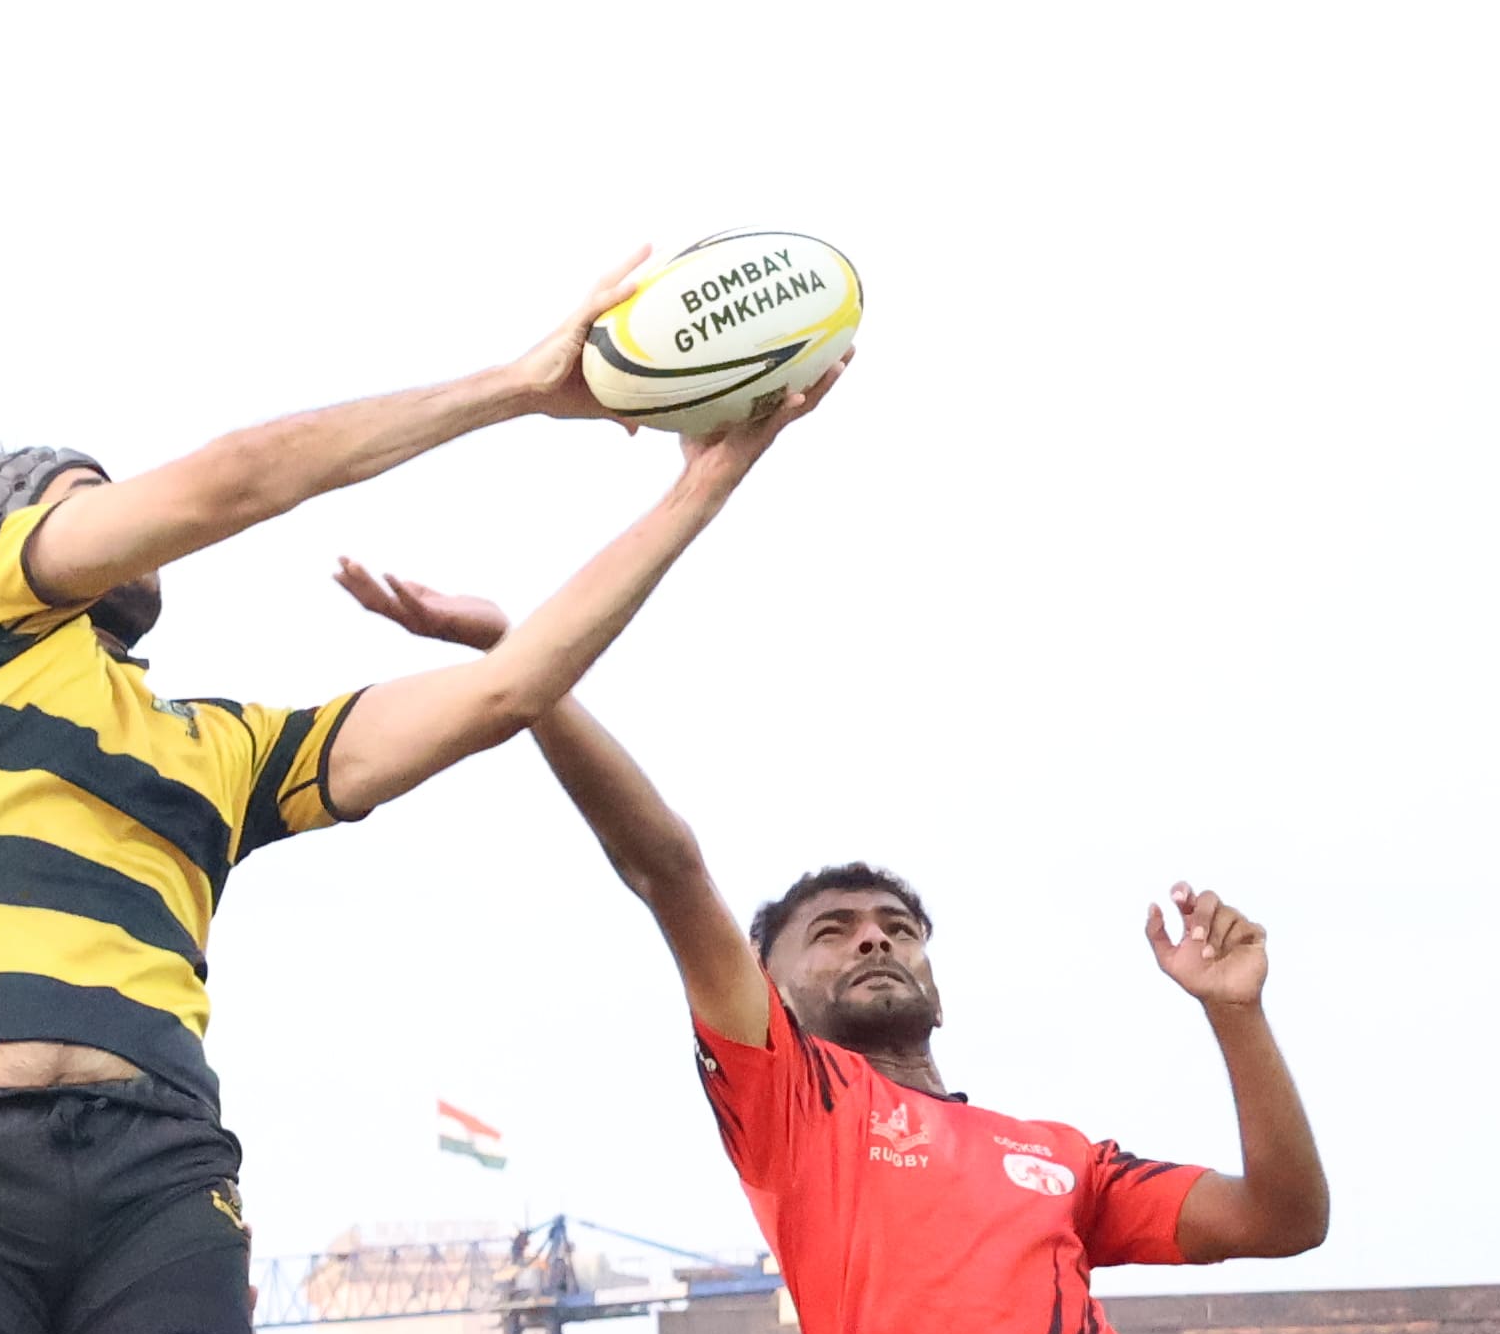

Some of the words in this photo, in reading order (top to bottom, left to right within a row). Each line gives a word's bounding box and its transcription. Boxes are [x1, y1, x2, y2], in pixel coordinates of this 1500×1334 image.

[674, 269, 826, 353] GYMKHANA
[680, 248, 792, 314] BOMBAY
[869, 1146, 929, 1169] RUGBY
